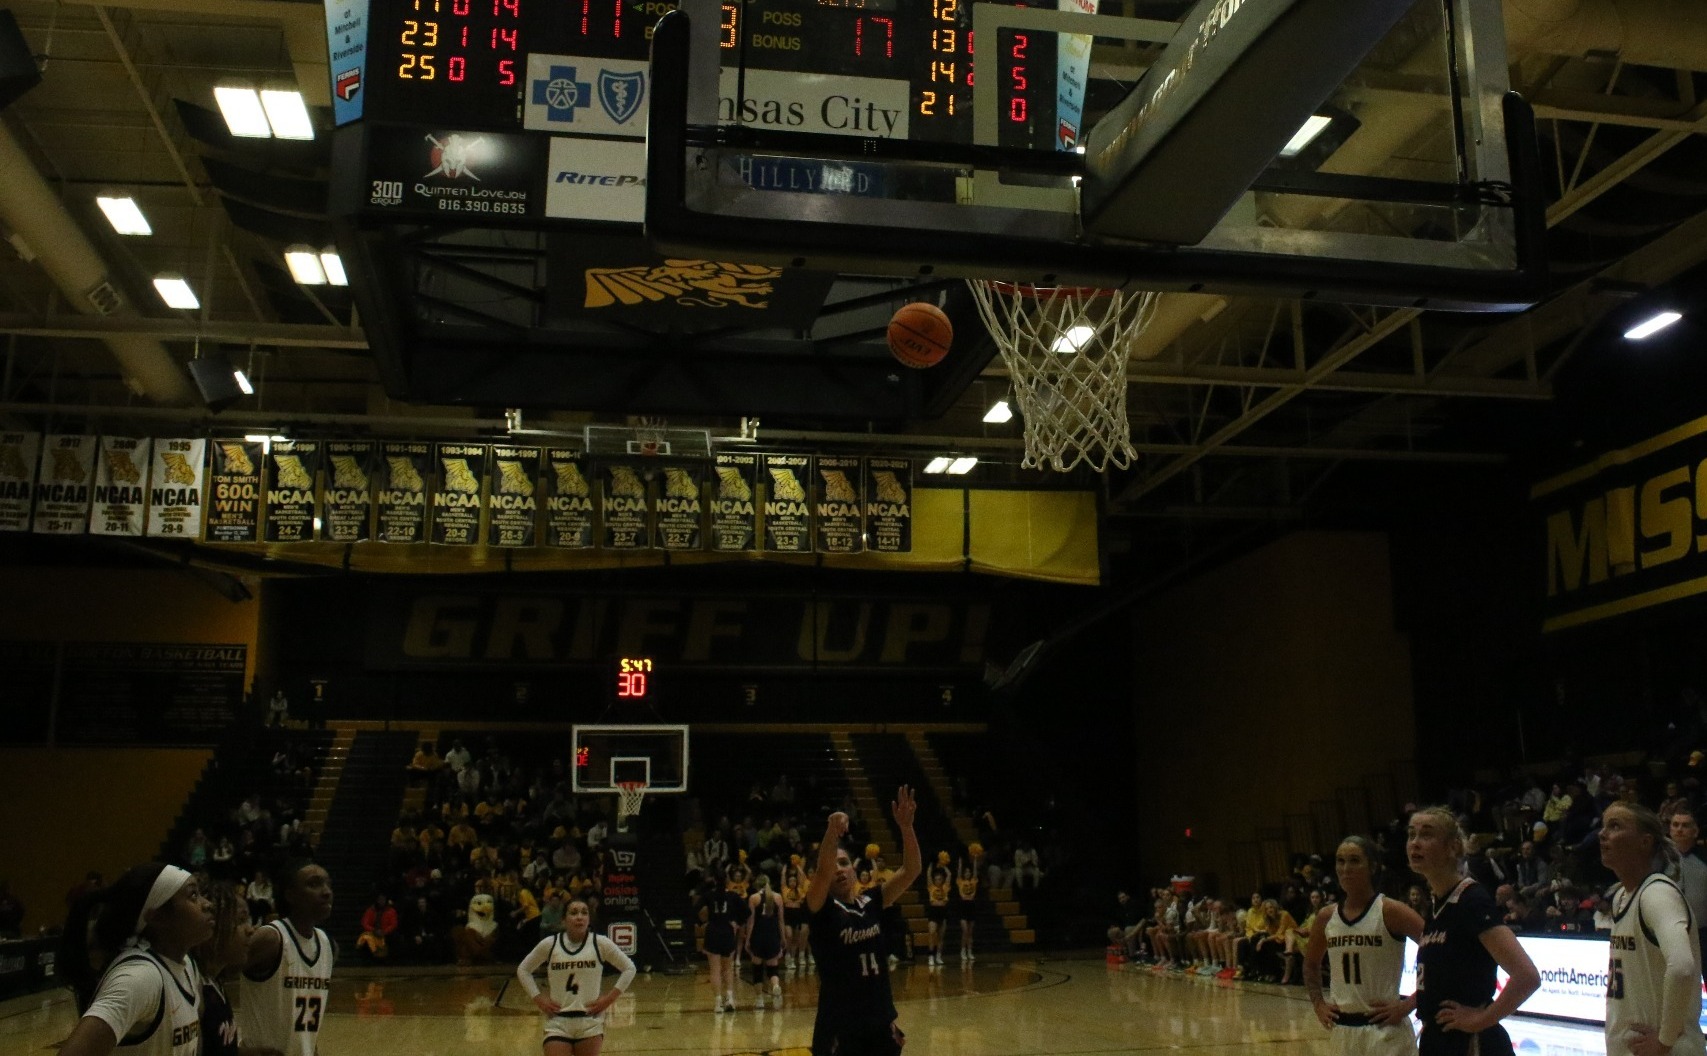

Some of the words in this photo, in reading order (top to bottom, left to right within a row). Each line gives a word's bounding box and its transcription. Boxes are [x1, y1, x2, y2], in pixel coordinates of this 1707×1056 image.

[335, 18, 361, 35] Mitchell
[763, 11, 801, 27] POSS
[401, 20, 438, 46] 23
[461, 25, 469, 48] 1
[491, 28, 518, 50] 14
[752, 34, 801, 50] BONUS
[855, 17, 893, 58] 17
[932, 29, 955, 53] 13
[333, 43, 364, 61] Riverside
[1013, 34, 1028, 59] 2
[399, 53, 435, 79] 25
[448, 56, 466, 81] 0
[499, 60, 515, 86] 5
[931, 61, 955, 83] 14
[1012, 66, 1027, 90] 5
[920, 91, 954, 116] 21
[1011, 98, 1027, 123] 0
[821, 95, 902, 137] City
[740, 157, 869, 193] HILLYD
[371, 181, 403, 199] 300
[371, 197, 403, 207] GROUP
[438, 199, 526, 215] 816.390.6835
[213, 475, 231, 484] TOM
[233, 476, 259, 484] SMITH
[37, 484, 88, 503] NCAA
[96, 485, 143, 505] NCAA
[152, 488, 200, 506] NCAA
[267, 490, 315, 504] NCAA
[324, 490, 370, 504] NCAA
[378, 491, 424, 505] NCAA
[434, 493, 480, 508] NCAA
[490, 495, 536, 510] NCAA
[215, 500, 252, 512] WIN
[547, 497, 593, 511] NCAA
[602, 497, 648, 511] NCAA
[656, 499, 700, 513] NCAA
[710, 500, 754, 515] NCAA
[765, 501, 809, 516] NCAA
[817, 503, 861, 517] NCAA
[867, 503, 909, 518] NCAA
[1547, 456, 1707, 598] MIS
[402, 595, 749, 662] GRIFF
[797, 600, 989, 665] UP!
[620, 658, 652, 673] 5:47
[618, 672, 646, 697] 30
[604, 896, 639, 906] online
[1328, 934, 1383, 948] GRIFFONS
[551, 960, 597, 971] GRIFFONS
[1342, 952, 1362, 985] 11
[565, 973, 579, 995] 4
[295, 997, 321, 1032] 23
